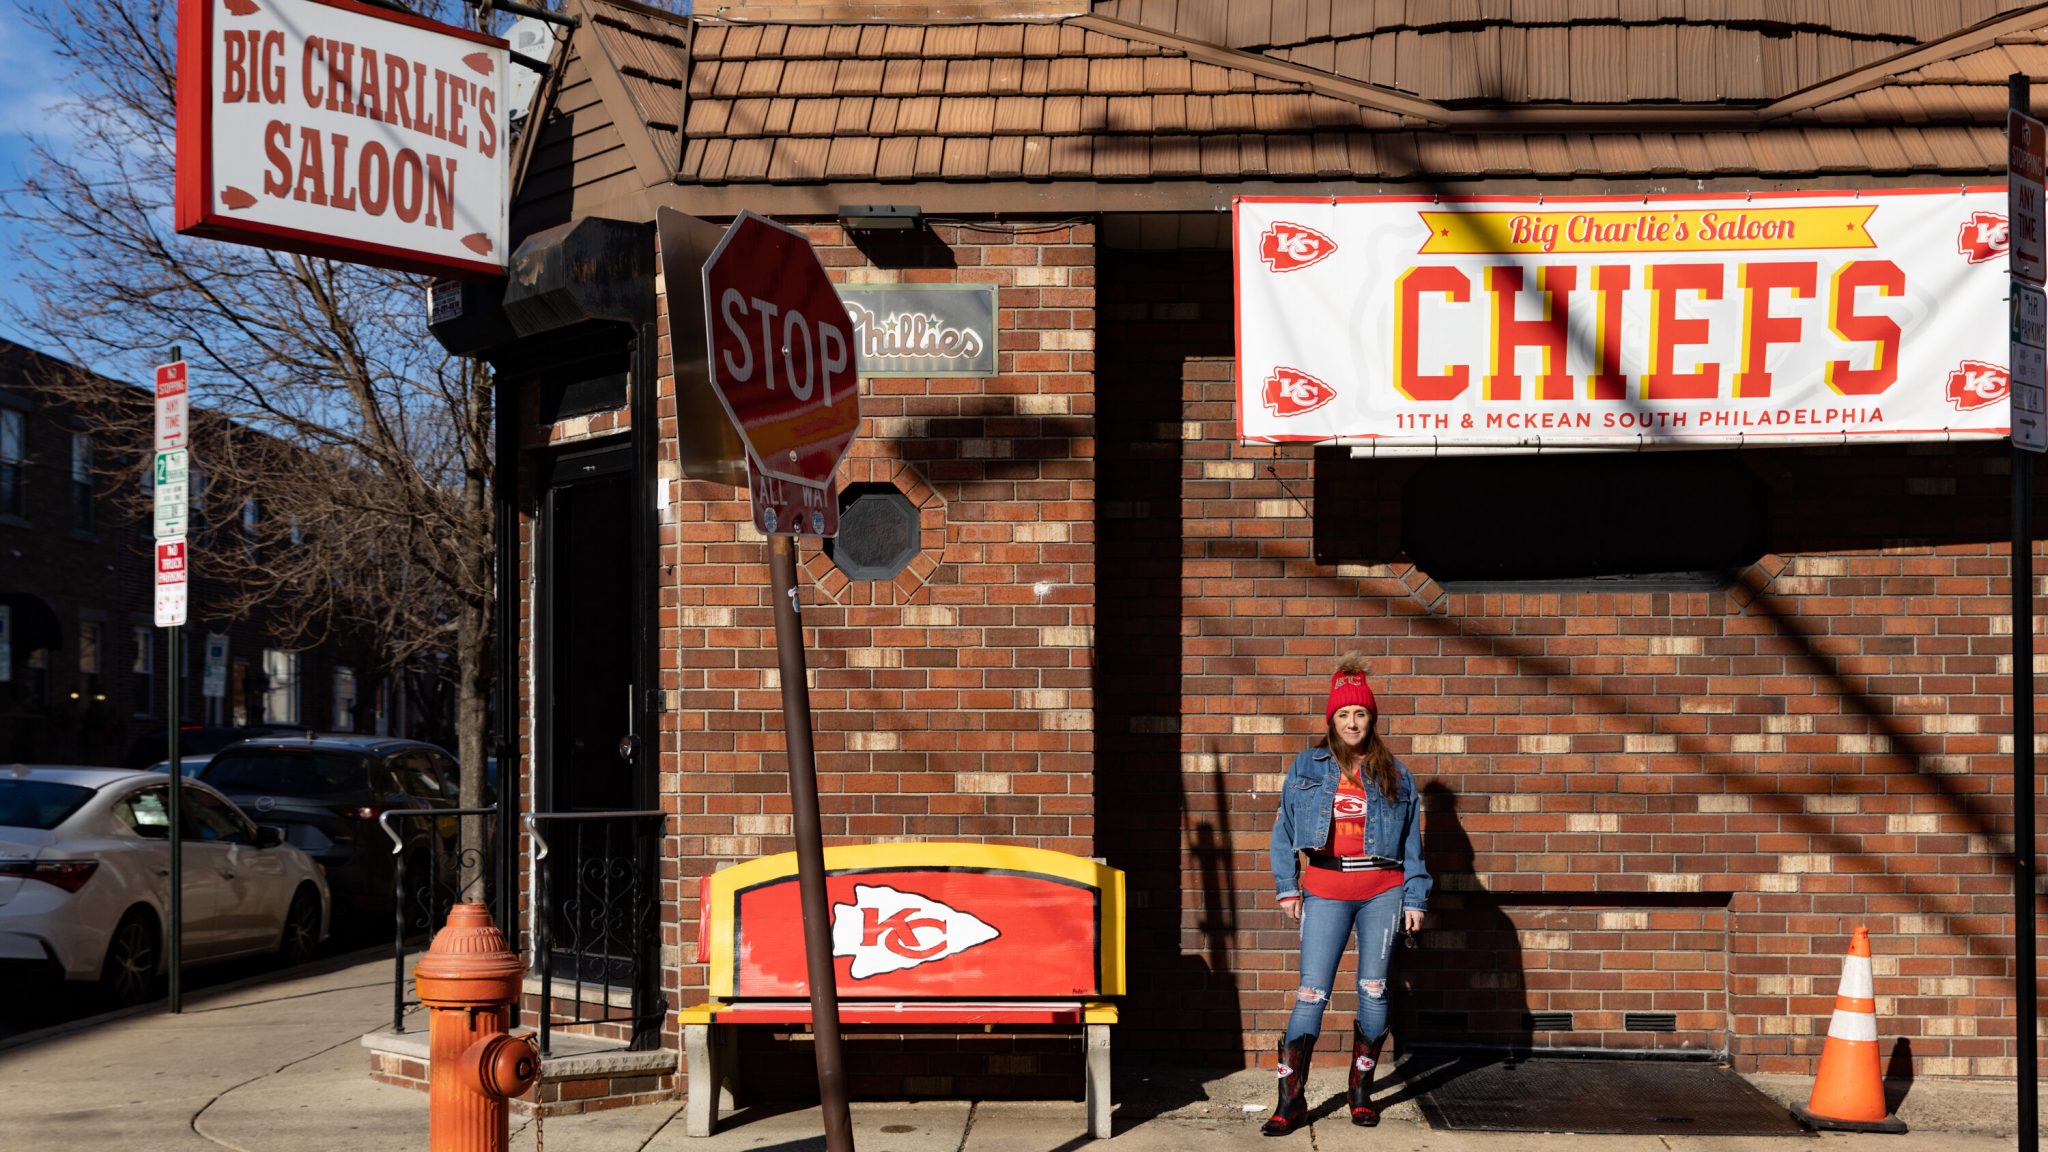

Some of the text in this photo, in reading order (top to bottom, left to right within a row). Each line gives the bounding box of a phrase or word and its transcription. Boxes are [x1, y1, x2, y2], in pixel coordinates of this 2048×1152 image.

[223, 30, 497, 159] BIG CHARLIE'S
[2021, 123, 2031, 147] NO
[264, 119, 457, 230] SALOON
[2011, 145, 2043, 176] STOPPING
[2018, 183, 2035, 212] ANY
[1508, 212, 1796, 252] Big Charlie's Saloon
[2018, 213, 2037, 243] TIME
[1276, 231, 1320, 262] KC
[2012, 293, 2019, 334] 2
[2027, 297, 2038, 317] HR
[1393, 259, 1906, 402] CHIEFS
[2021, 320, 2045, 345] PARKING
[720, 287, 848, 408] STOP
[1279, 377, 1320, 407] KC
[1963, 370, 2008, 400] KC
[1396, 407, 1885, 429] 11TH & MCKEAN SOUTH PHILADELPHIA
[158, 459, 165, 481] 2
[759, 475, 829, 508] ALL WAY
[161, 557, 184, 570] TRUCK
[859, 907, 948, 959] KC
